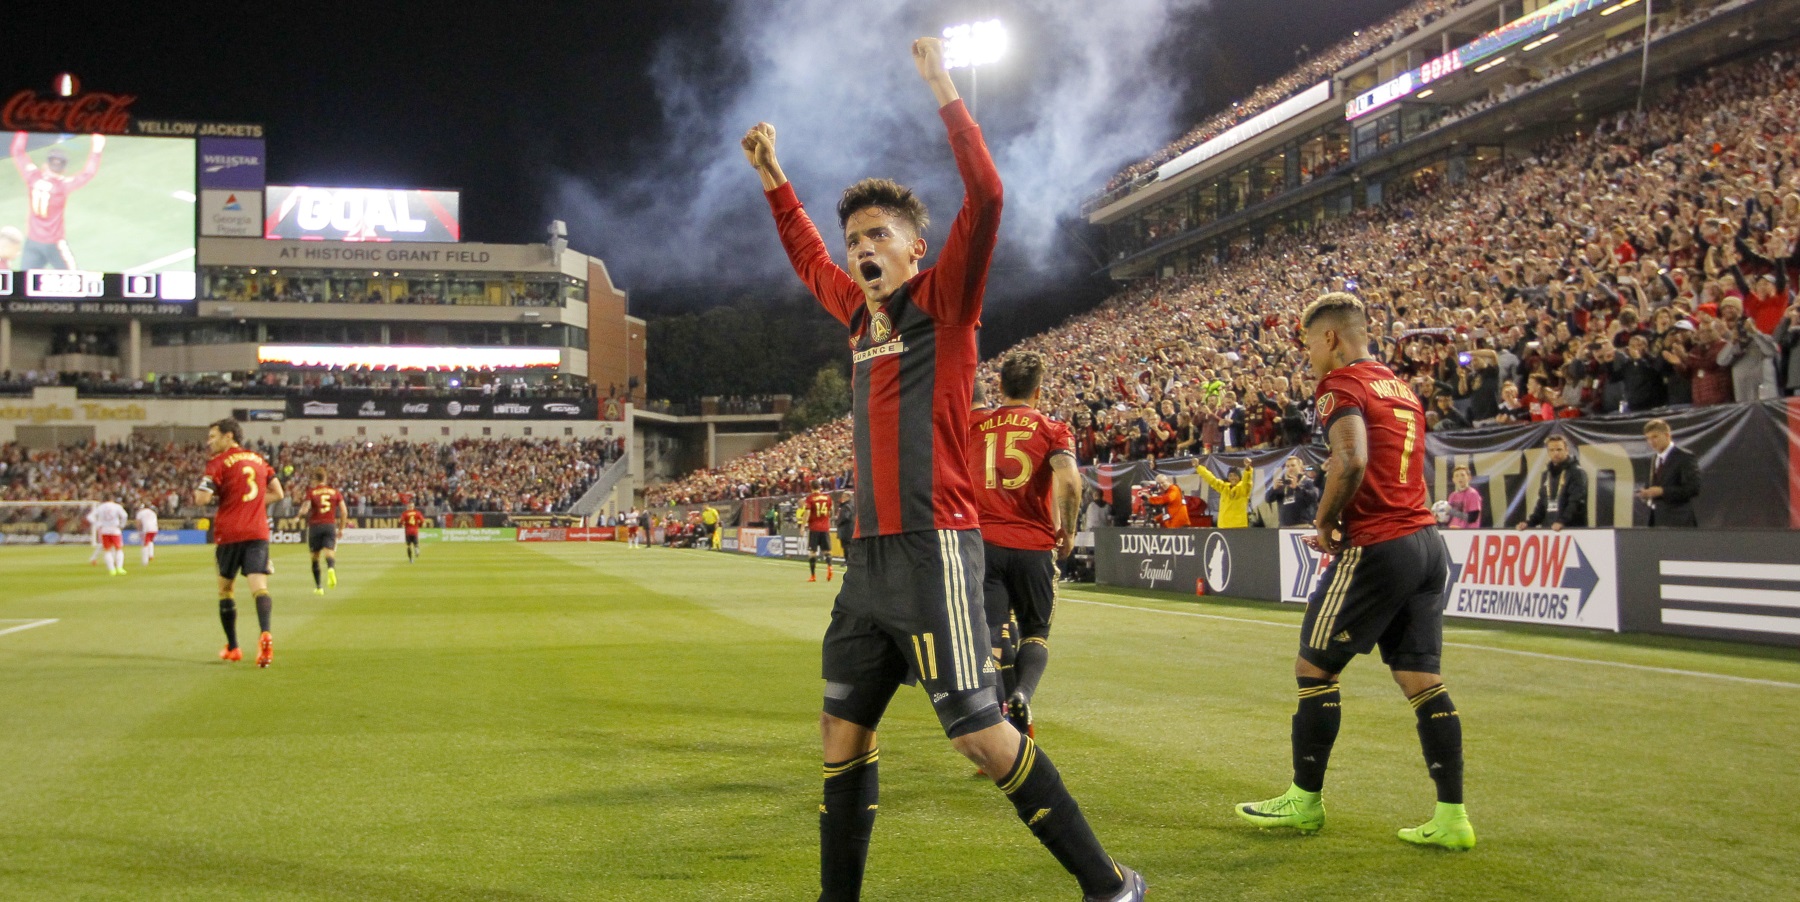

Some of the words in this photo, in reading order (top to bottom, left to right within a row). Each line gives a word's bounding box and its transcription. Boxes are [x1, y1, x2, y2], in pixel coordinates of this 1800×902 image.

[1420, 49, 1462, 84] GOAL
[138, 121, 197, 134] YELLOW
[199, 123, 263, 137] JACKETS
[297, 189, 427, 232] GOAL
[279, 247, 299, 258] AT
[305, 248, 381, 260] HISTORIC
[386, 249, 440, 261] GRANT
[446, 251, 490, 263] FIELD
[9, 302, 75, 313] CHAMPIONS
[463, 404, 481, 412] AT&T
[979, 413, 1039, 431] VILLALBA
[1392, 408, 1416, 484] 7
[984, 431, 1034, 490] 15
[242, 465, 260, 503] 3
[320, 494, 331, 515] 5
[815, 502, 829, 518] 14
[409, 516, 416, 526] 4
[1120, 534, 1195, 556] LUNAZUL
[1140, 558, 1173, 588] Tequila
[1461, 534, 1572, 588] ARROW
[1457, 588, 1569, 620] EXTERMINATORS
[911, 632, 938, 680] 11
